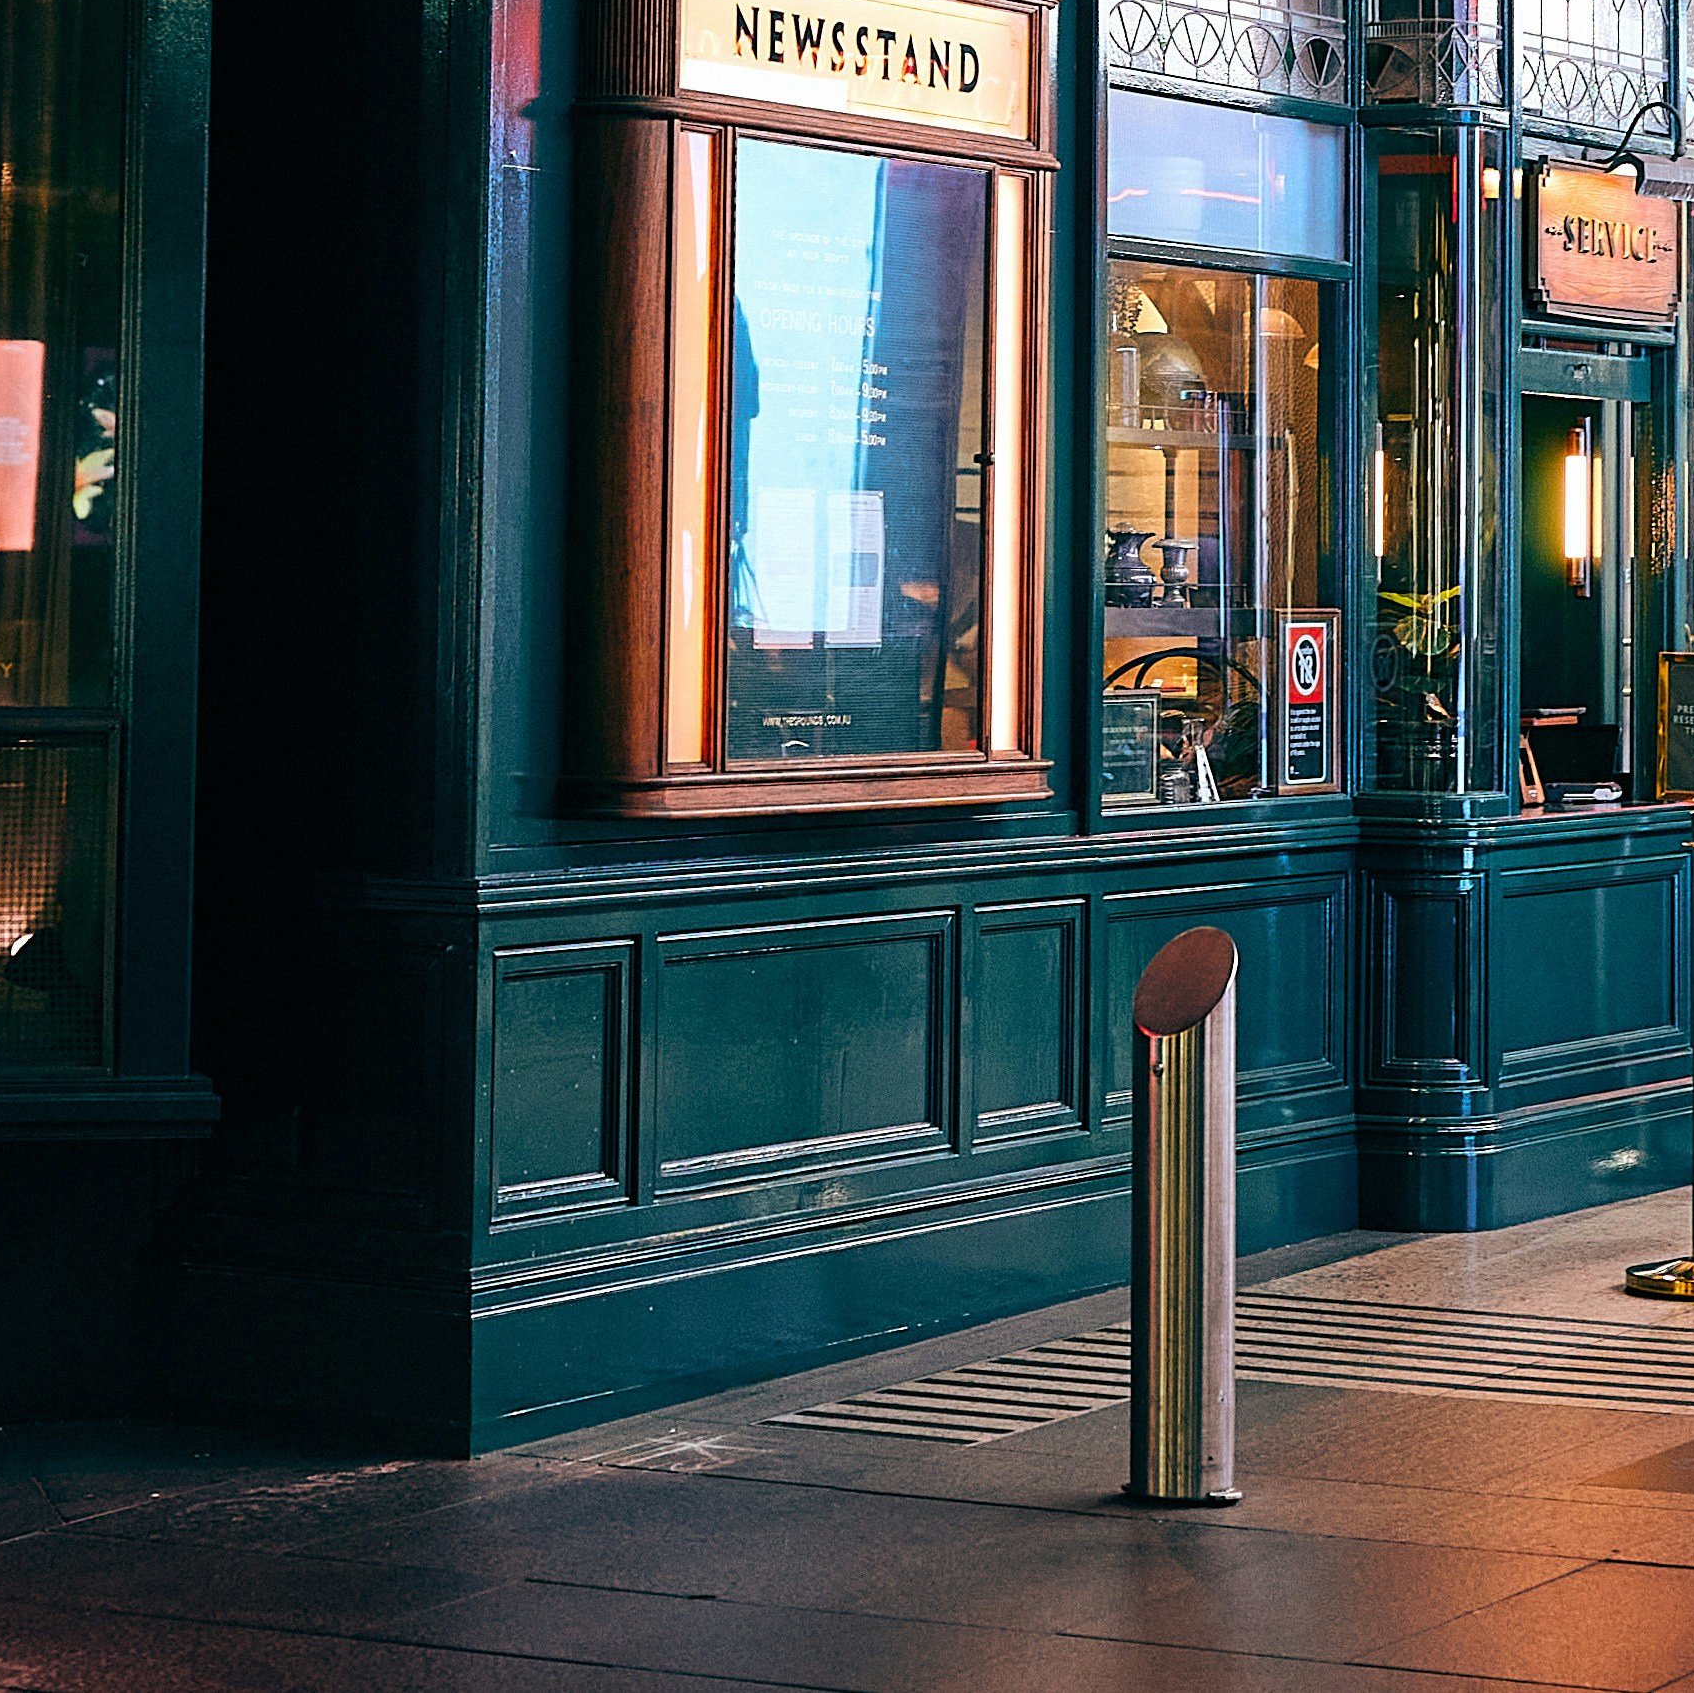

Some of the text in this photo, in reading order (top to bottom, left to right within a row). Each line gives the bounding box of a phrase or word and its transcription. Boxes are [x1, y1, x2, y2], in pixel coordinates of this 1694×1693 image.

[733, 2, 980, 94] NEWSSTAND
[1562, 214, 1658, 264] SERVICE
[760, 307, 875, 338] OPENING HOURS
[1298, 655, 1314, 684] 18
